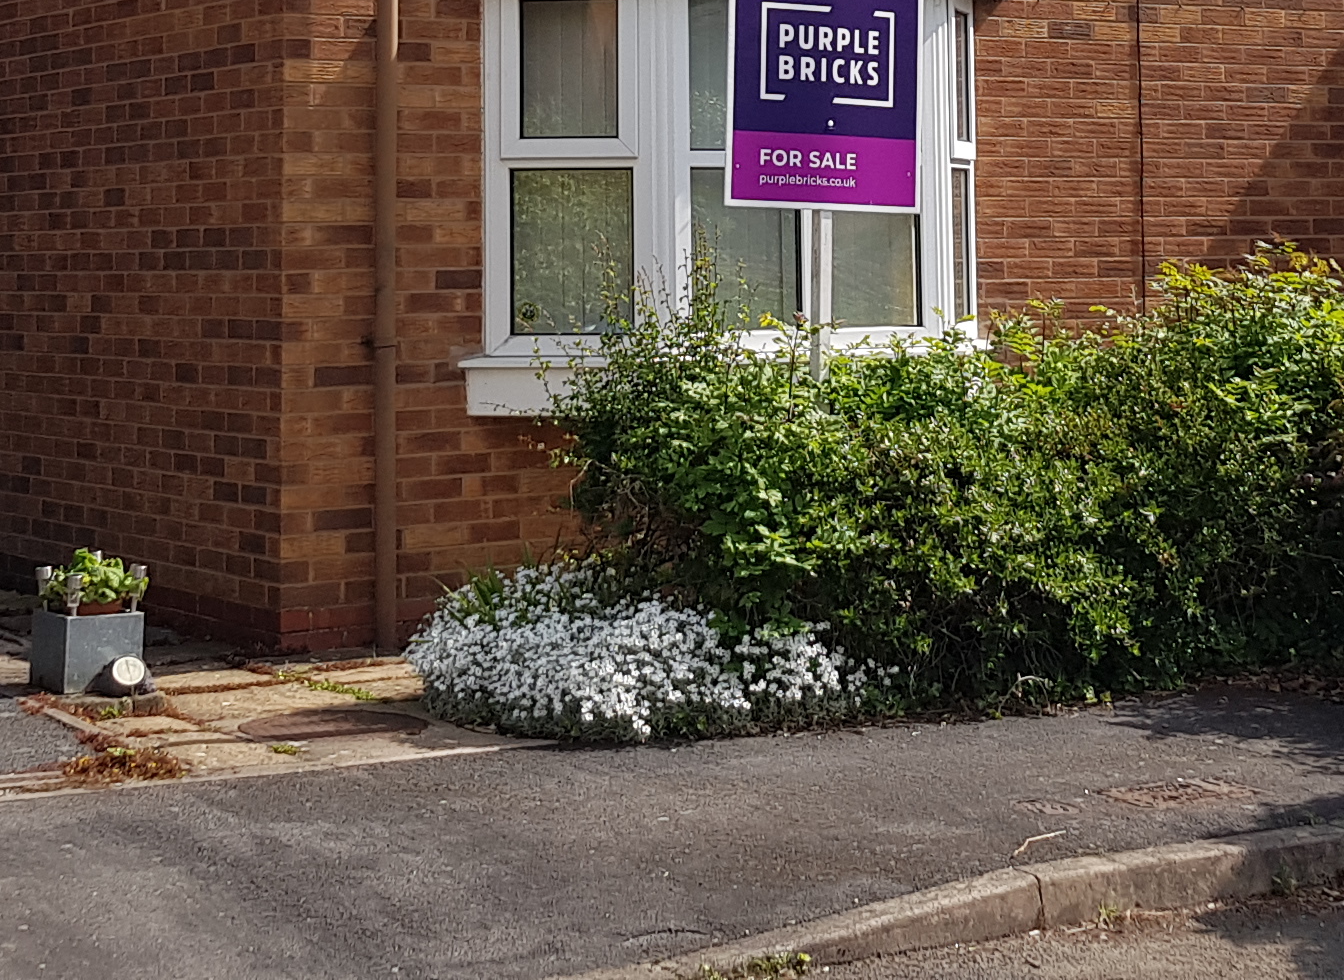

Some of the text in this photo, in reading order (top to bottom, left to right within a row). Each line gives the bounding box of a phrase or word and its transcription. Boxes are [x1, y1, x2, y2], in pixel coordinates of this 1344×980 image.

[779, 23, 879, 55] PURPLE
[778, 55, 879, 86] BRICKS
[759, 148, 857, 170] FOR SALE
[759, 173, 856, 188] purplebricks.co.uk
